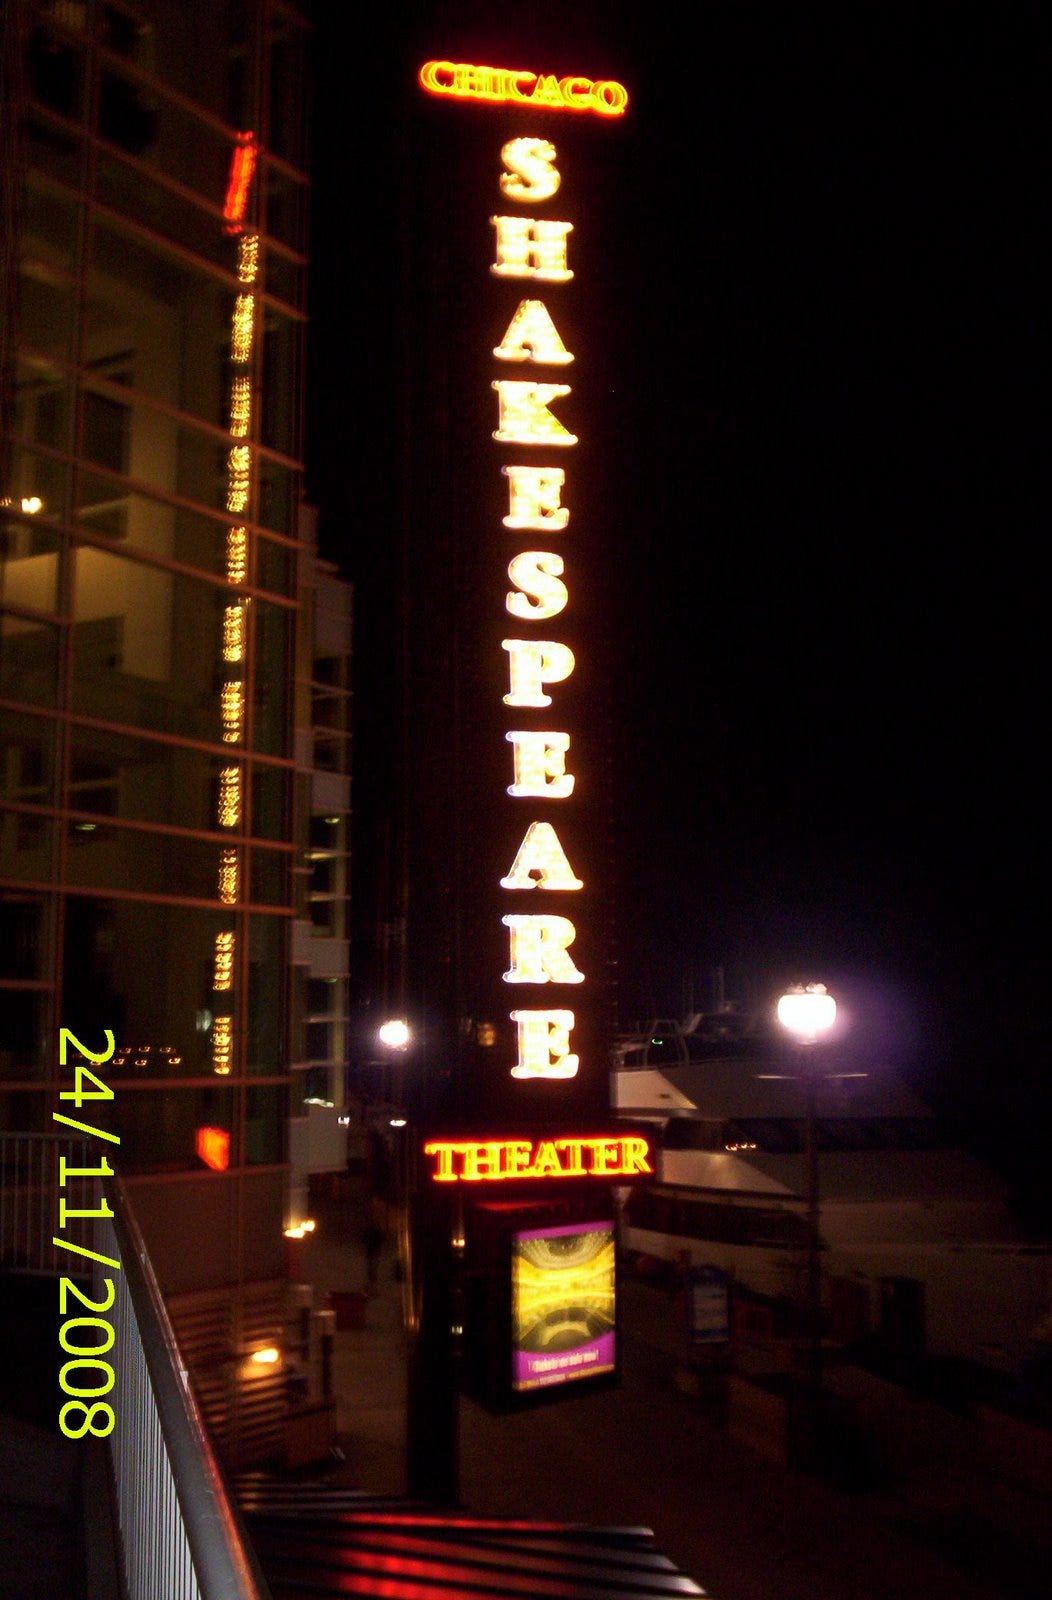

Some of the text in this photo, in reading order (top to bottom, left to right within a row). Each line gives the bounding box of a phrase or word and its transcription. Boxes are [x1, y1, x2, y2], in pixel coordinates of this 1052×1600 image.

[419, 60, 629, 118] CHICAGO
[490, 136, 585, 1081] SHAKESPEARE
[424, 1136, 652, 1183] THEATER
